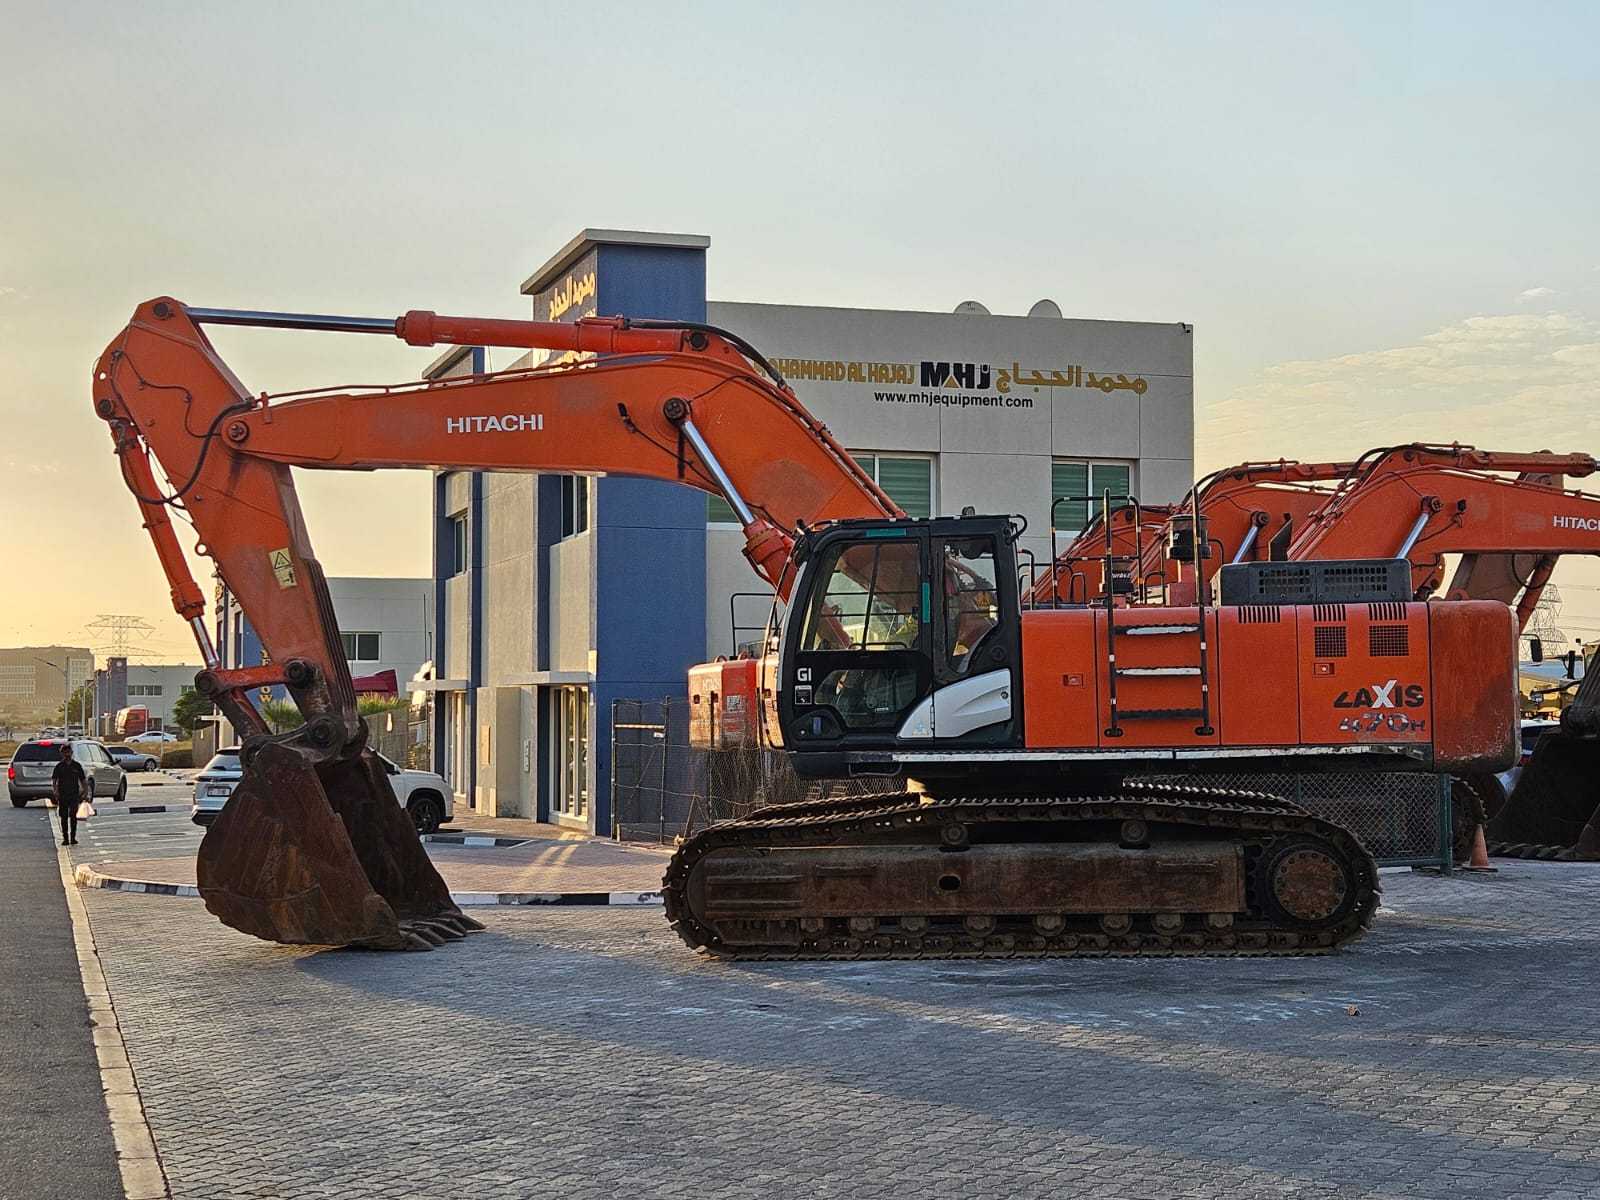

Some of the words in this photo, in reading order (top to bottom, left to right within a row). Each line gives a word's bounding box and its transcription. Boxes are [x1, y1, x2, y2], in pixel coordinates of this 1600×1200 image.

[847, 361, 866, 382] AL
[996, 362, 1082, 393] الحجاج
[1085, 372, 1148, 394] محمد
[874, 391, 1033, 408] www.mhjequipment.com
[447, 413, 544, 434] HITACHI
[1552, 515, 1600, 531] HITAC
